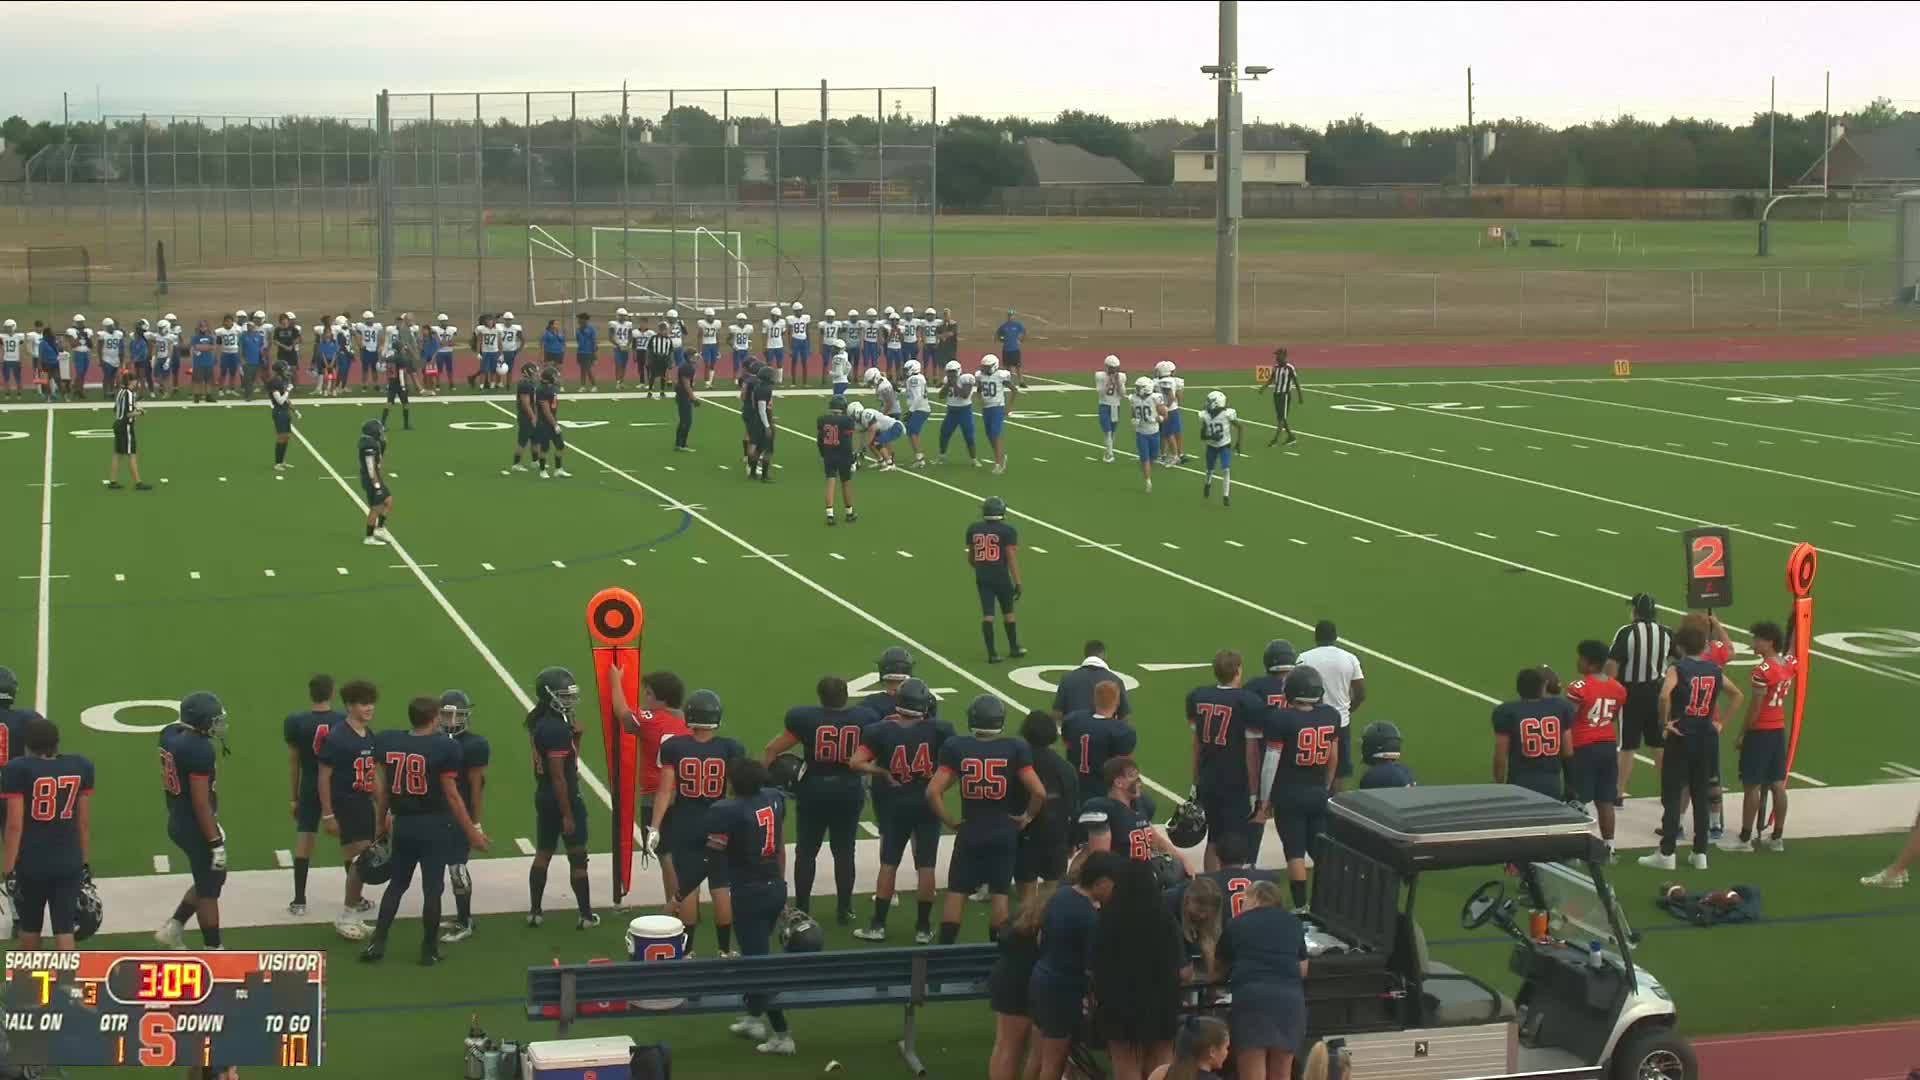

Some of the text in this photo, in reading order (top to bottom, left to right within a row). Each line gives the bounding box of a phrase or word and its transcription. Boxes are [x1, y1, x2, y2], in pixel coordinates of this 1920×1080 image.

[5, 340, 17, 353] 19
[364, 330, 376, 343] 94
[770, 327, 780, 338] 10
[1258, 367, 1271, 380] 20
[823, 424, 840, 446] 31
[973, 533, 1000, 561] 26
[1692, 535, 1725, 579] 2
[1587, 697, 1617, 728] 45
[1685, 676, 1715, 717] 17
[815, 725, 862, 763] 60
[1197, 703, 1233, 746] 77
[1520, 715, 1561, 758] 69
[889, 742, 934, 785] 44
[1079, 734, 1091, 774] 1
[1295, 725, 1336, 767] 95
[386, 751, 428, 795] 78
[679, 757, 726, 799] 98
[961, 757, 1009, 801] 25
[31, 774, 82, 822] 87
[755, 805, 775, 857] 7
